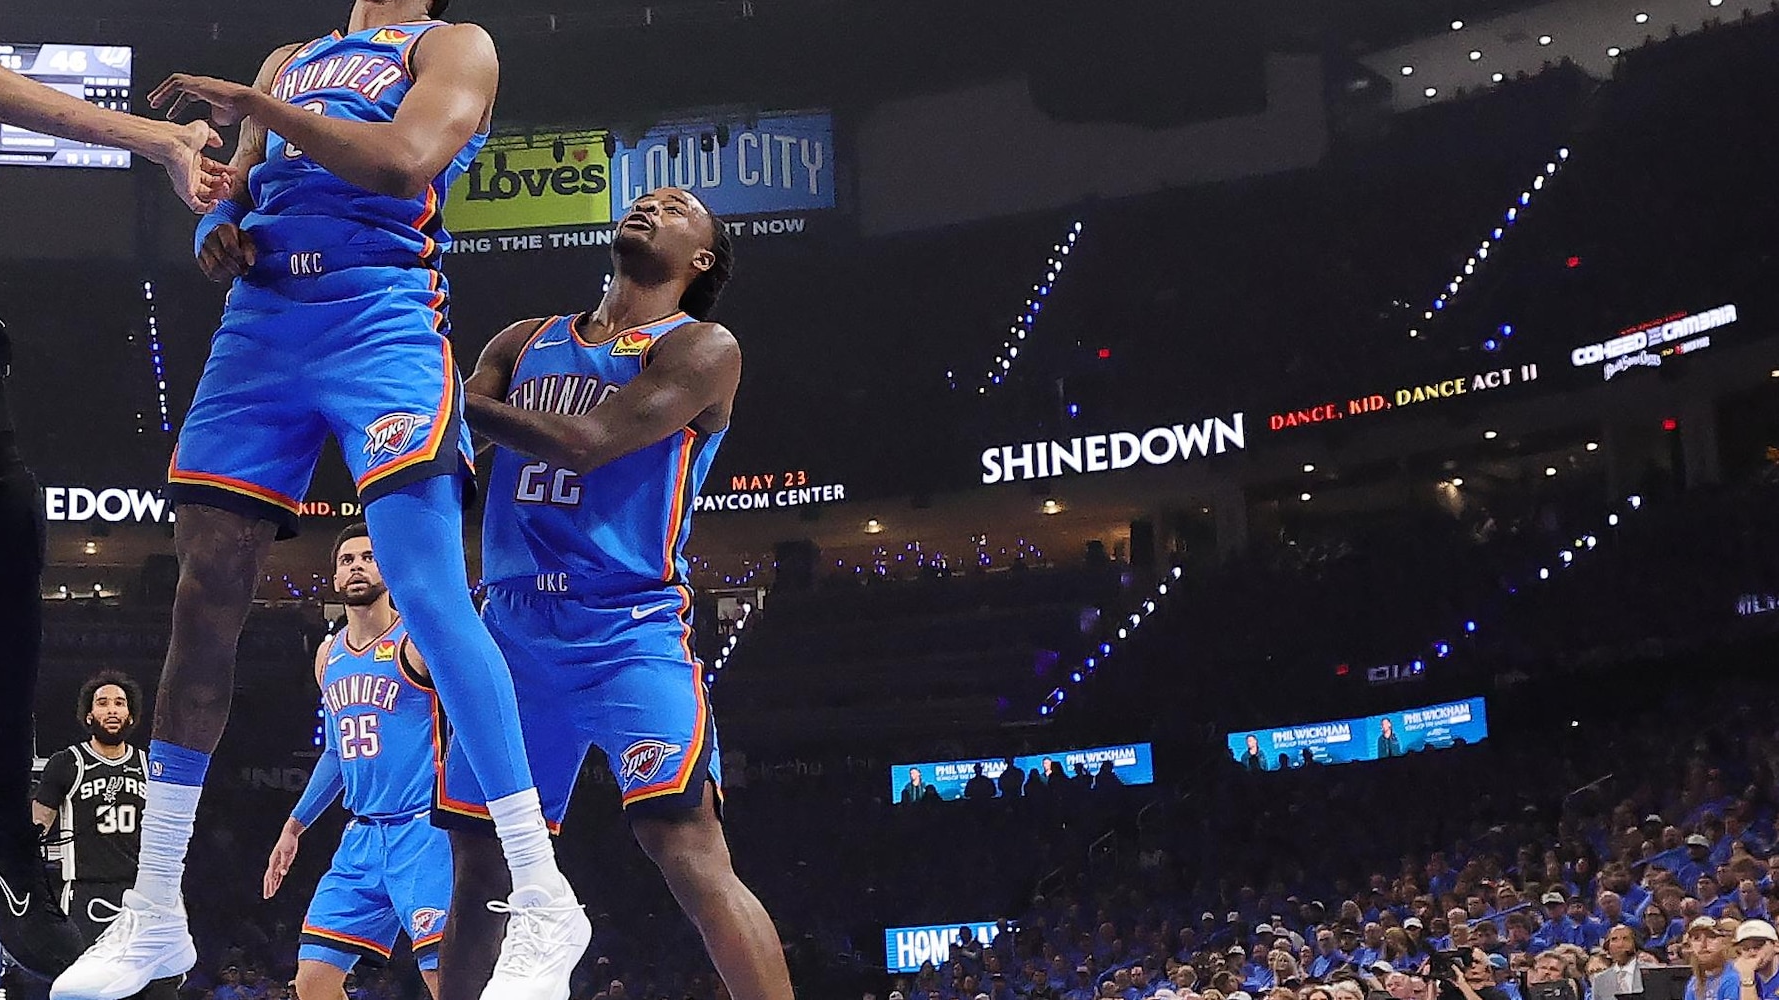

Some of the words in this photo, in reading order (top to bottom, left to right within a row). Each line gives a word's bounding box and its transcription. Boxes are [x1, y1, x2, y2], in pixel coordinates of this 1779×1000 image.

[737, 131, 823, 196] CITY
[498, 234, 544, 251] THE
[752, 218, 807, 237] NOW
[290, 253, 323, 275] OKC
[1572, 331, 1648, 367] COHEED
[1269, 403, 1344, 431] DANCE,
[1348, 394, 1393, 417] KID,
[1396, 377, 1467, 407] DANCE
[1471, 369, 1512, 393] ACT
[1520, 363, 1538, 383] II
[981, 412, 1246, 485] SHINEDOWN
[732, 474, 774, 491] MAY
[784, 471, 807, 487] 23
[694, 492, 770, 512] PAYCOM
[775, 484, 845, 506] CENTER
[536, 572, 569, 593] OKC
[324, 675, 400, 715] THUNDER
[1403, 711, 1422, 724] PHIL
[1422, 703, 1470, 721] WICKHAM
[340, 714, 379, 760] 25
[1272, 730, 1295, 743] PHIL
[1294, 723, 1350, 740] WICKHAM
[935, 764, 957, 776] PHIL
[1066, 753, 1087, 765] PHIL
[1087, 747, 1136, 763] WICKHAM
[80, 776, 148, 802] SPURS
[96, 804, 136, 834] 30
